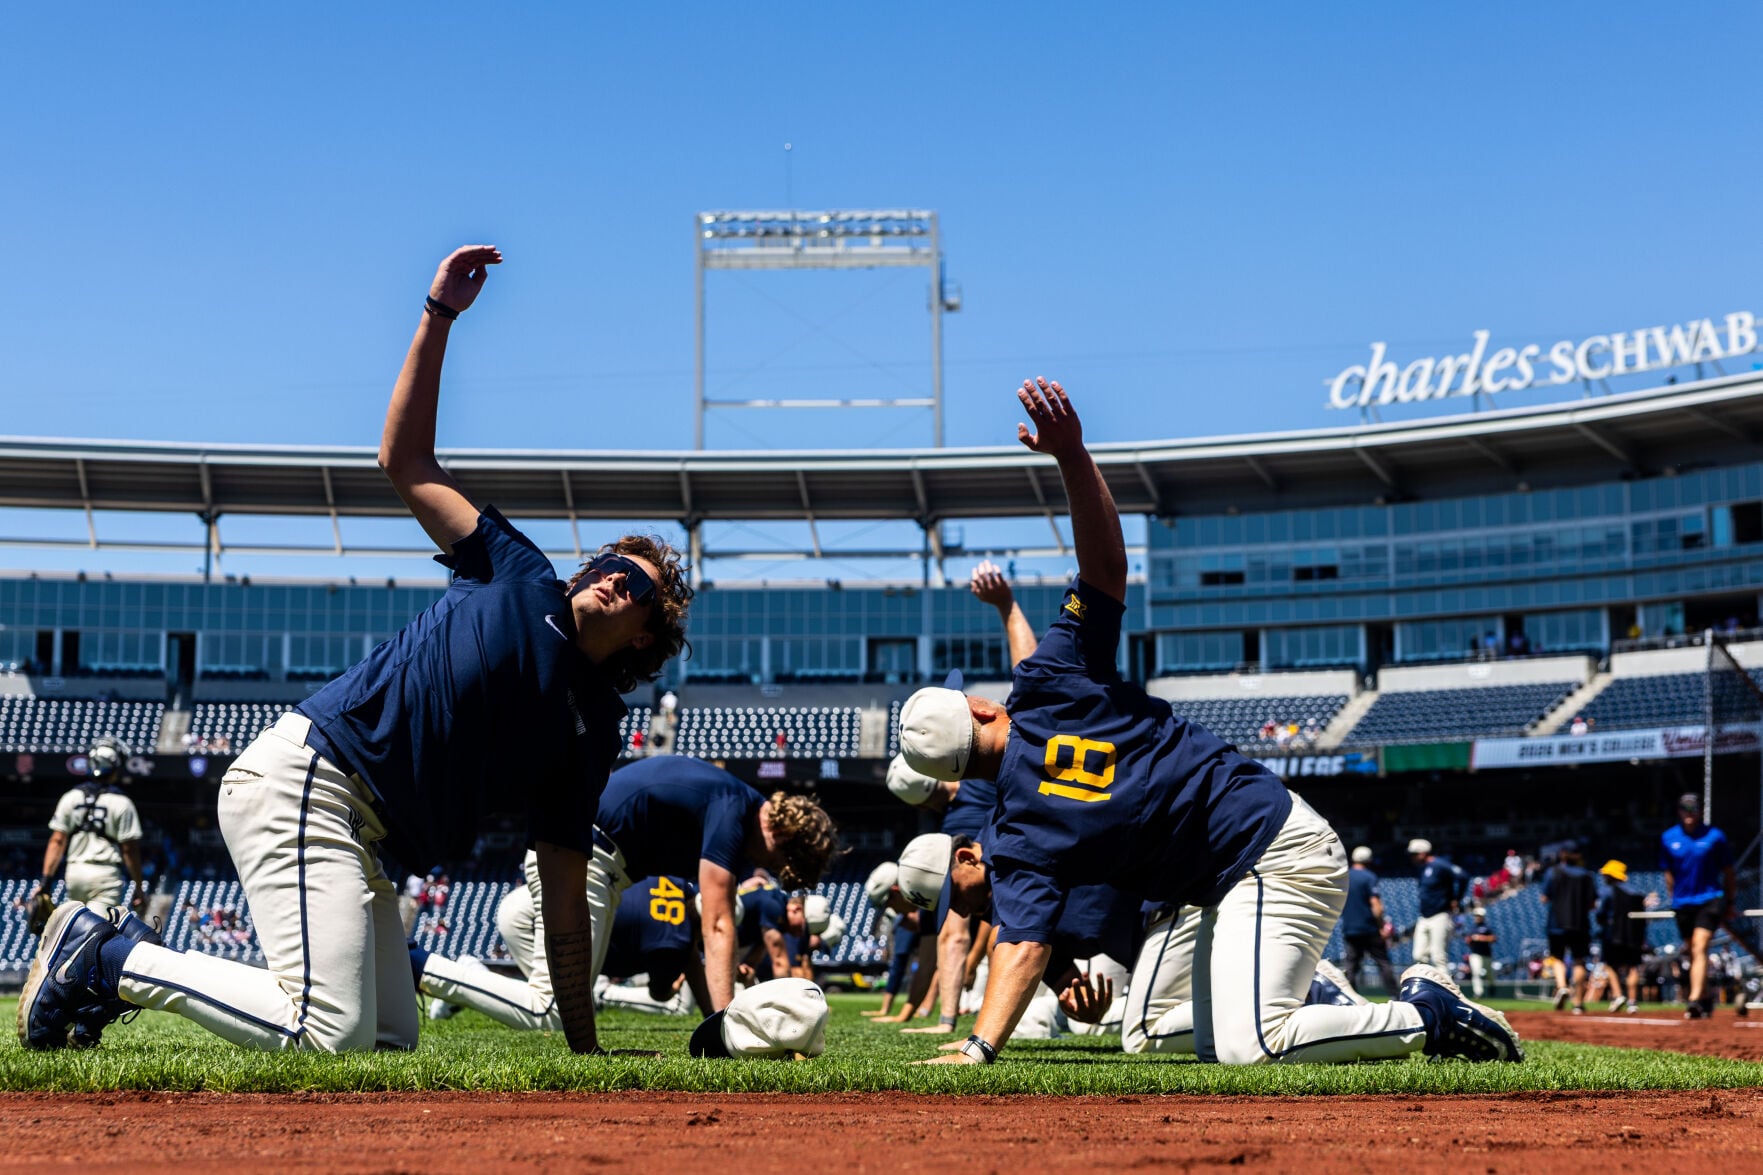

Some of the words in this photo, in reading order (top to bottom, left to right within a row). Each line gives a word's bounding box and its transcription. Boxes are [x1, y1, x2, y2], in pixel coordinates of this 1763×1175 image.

[1329, 329, 1540, 409] charles
[1549, 310, 1759, 384] SCHWAB
[1037, 734, 1117, 803] 18
[1558, 739, 1597, 756] MEN'S
[1601, 735, 1656, 753] COLLEGE
[649, 876, 686, 925] 48
